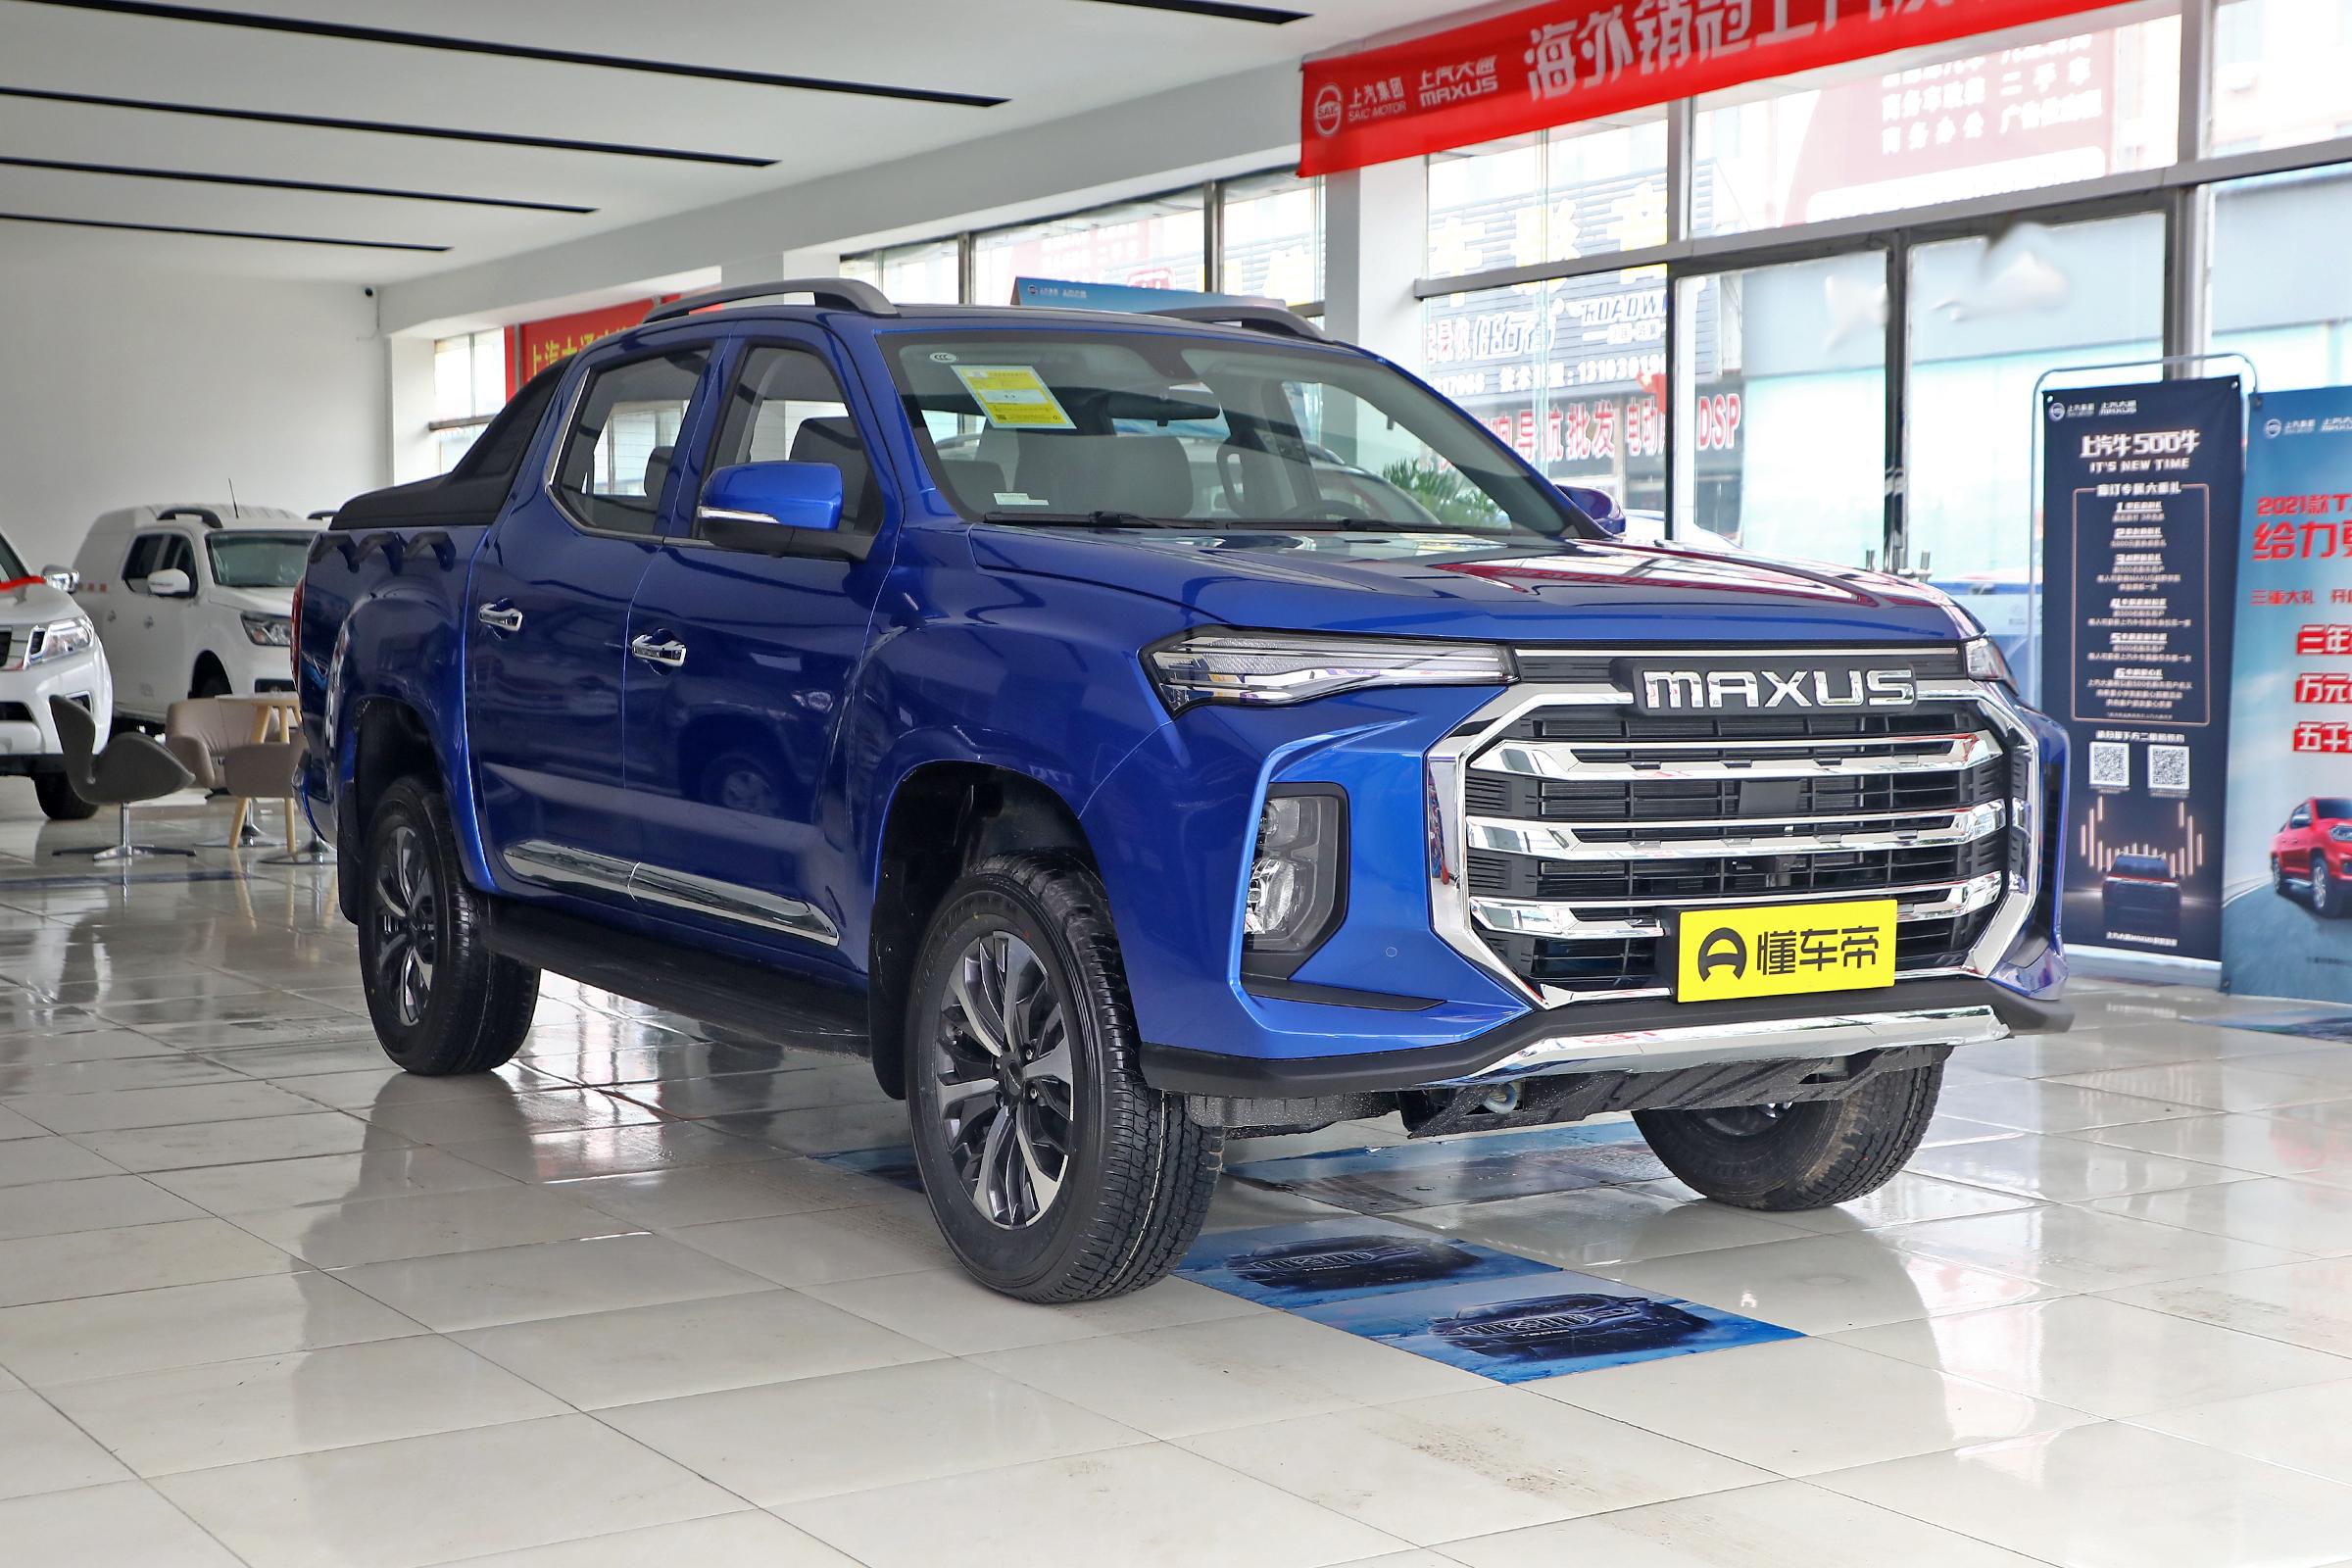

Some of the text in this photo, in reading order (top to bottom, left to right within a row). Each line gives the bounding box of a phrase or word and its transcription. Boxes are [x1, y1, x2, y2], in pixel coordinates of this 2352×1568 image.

[1348, 76, 1405, 109] 上汽集团
[1420, 75, 1498, 108] MAXUS
[1348, 101, 1406, 122] SAIC MOTOR
[1696, 393, 1741, 451] DSP
[2089, 458, 2190, 473] IT'S NEW TIME
[2257, 494, 2352, 515] 2021款T
[2252, 519, 2352, 561] 给力
[2298, 624, 2352, 654] 三年
[1643, 670, 1914, 709] MAXUS
[2298, 673, 2352, 703] 万元
[2295, 722, 2352, 752] 五千
[1757, 926, 1880, 975] 懂车帝
